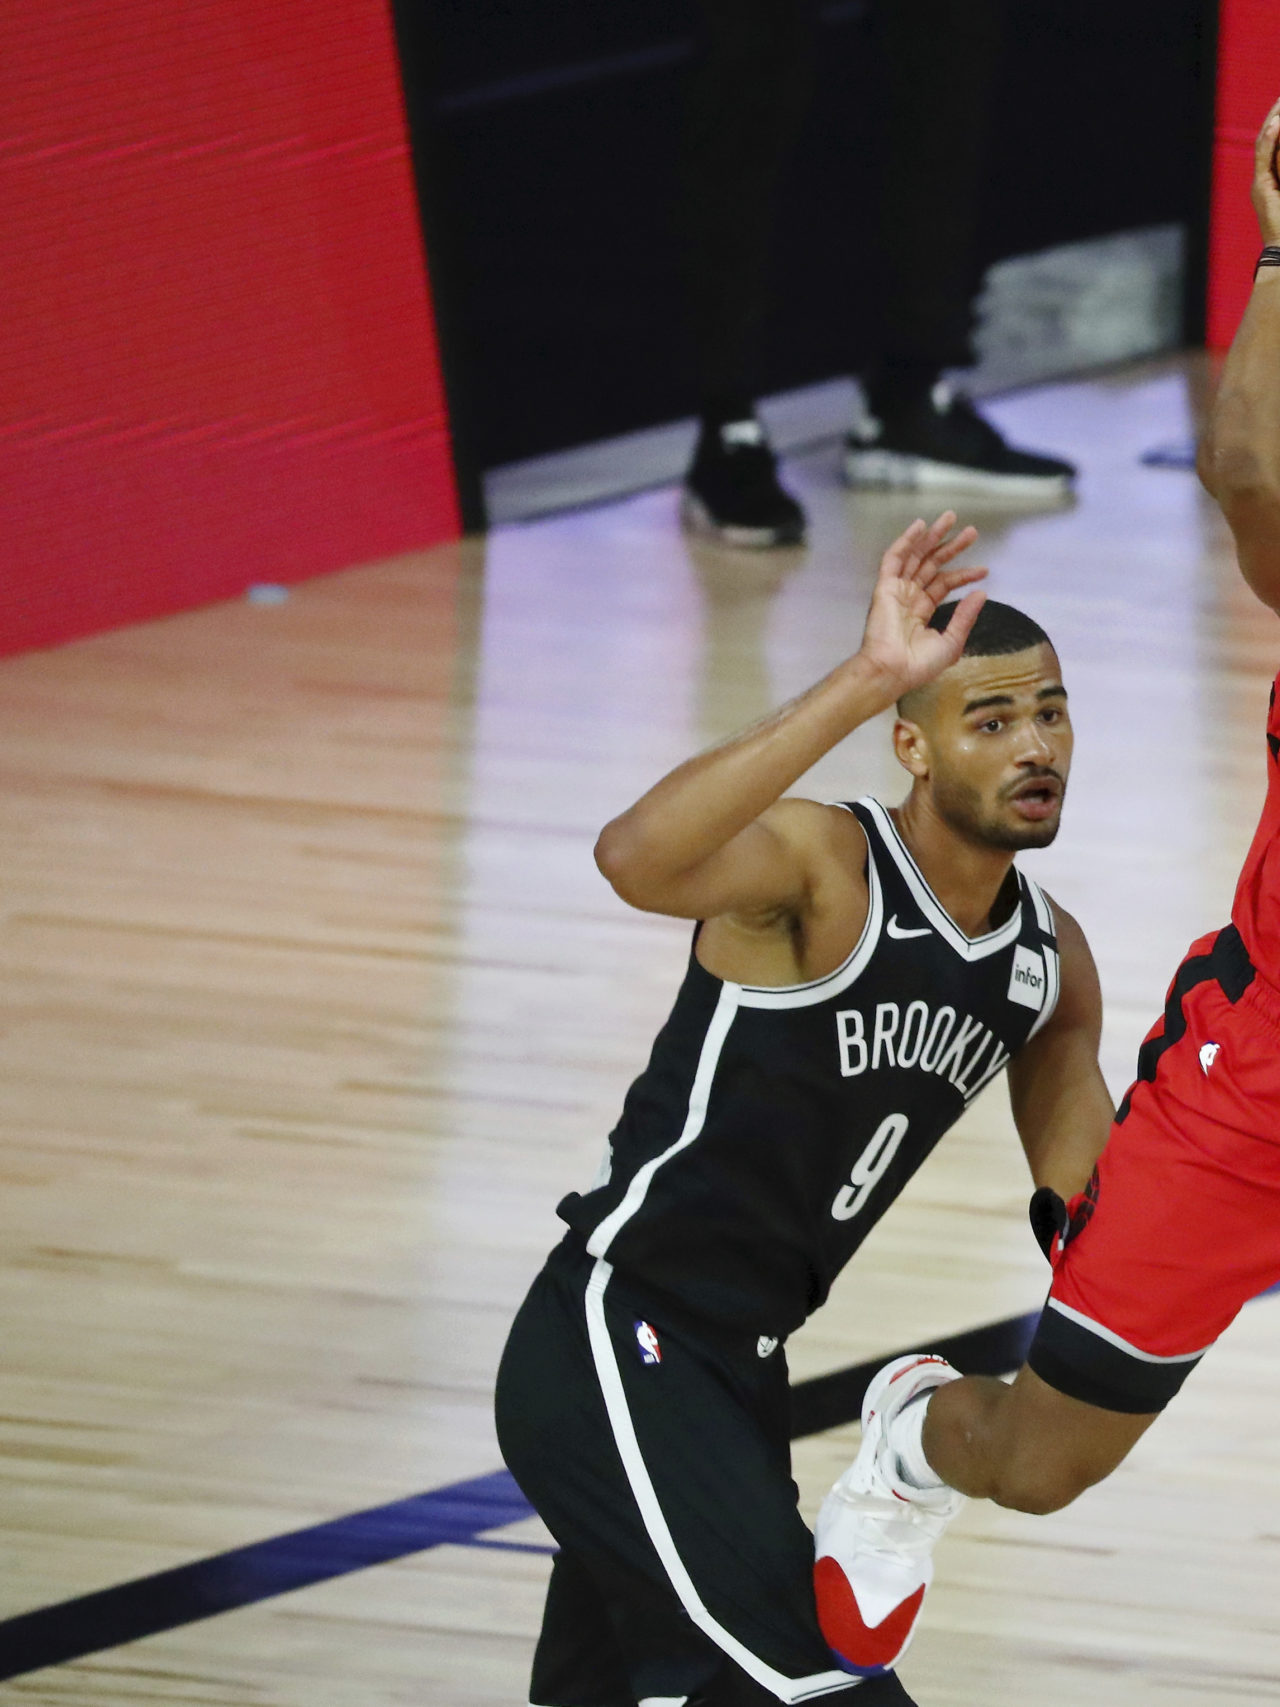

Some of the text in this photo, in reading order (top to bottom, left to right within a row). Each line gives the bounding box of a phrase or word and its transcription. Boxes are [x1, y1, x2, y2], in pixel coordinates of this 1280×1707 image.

[1015, 964, 1042, 989] infor
[836, 1000, 1011, 1108] BROOKLY
[831, 1113, 909, 1221] 9
